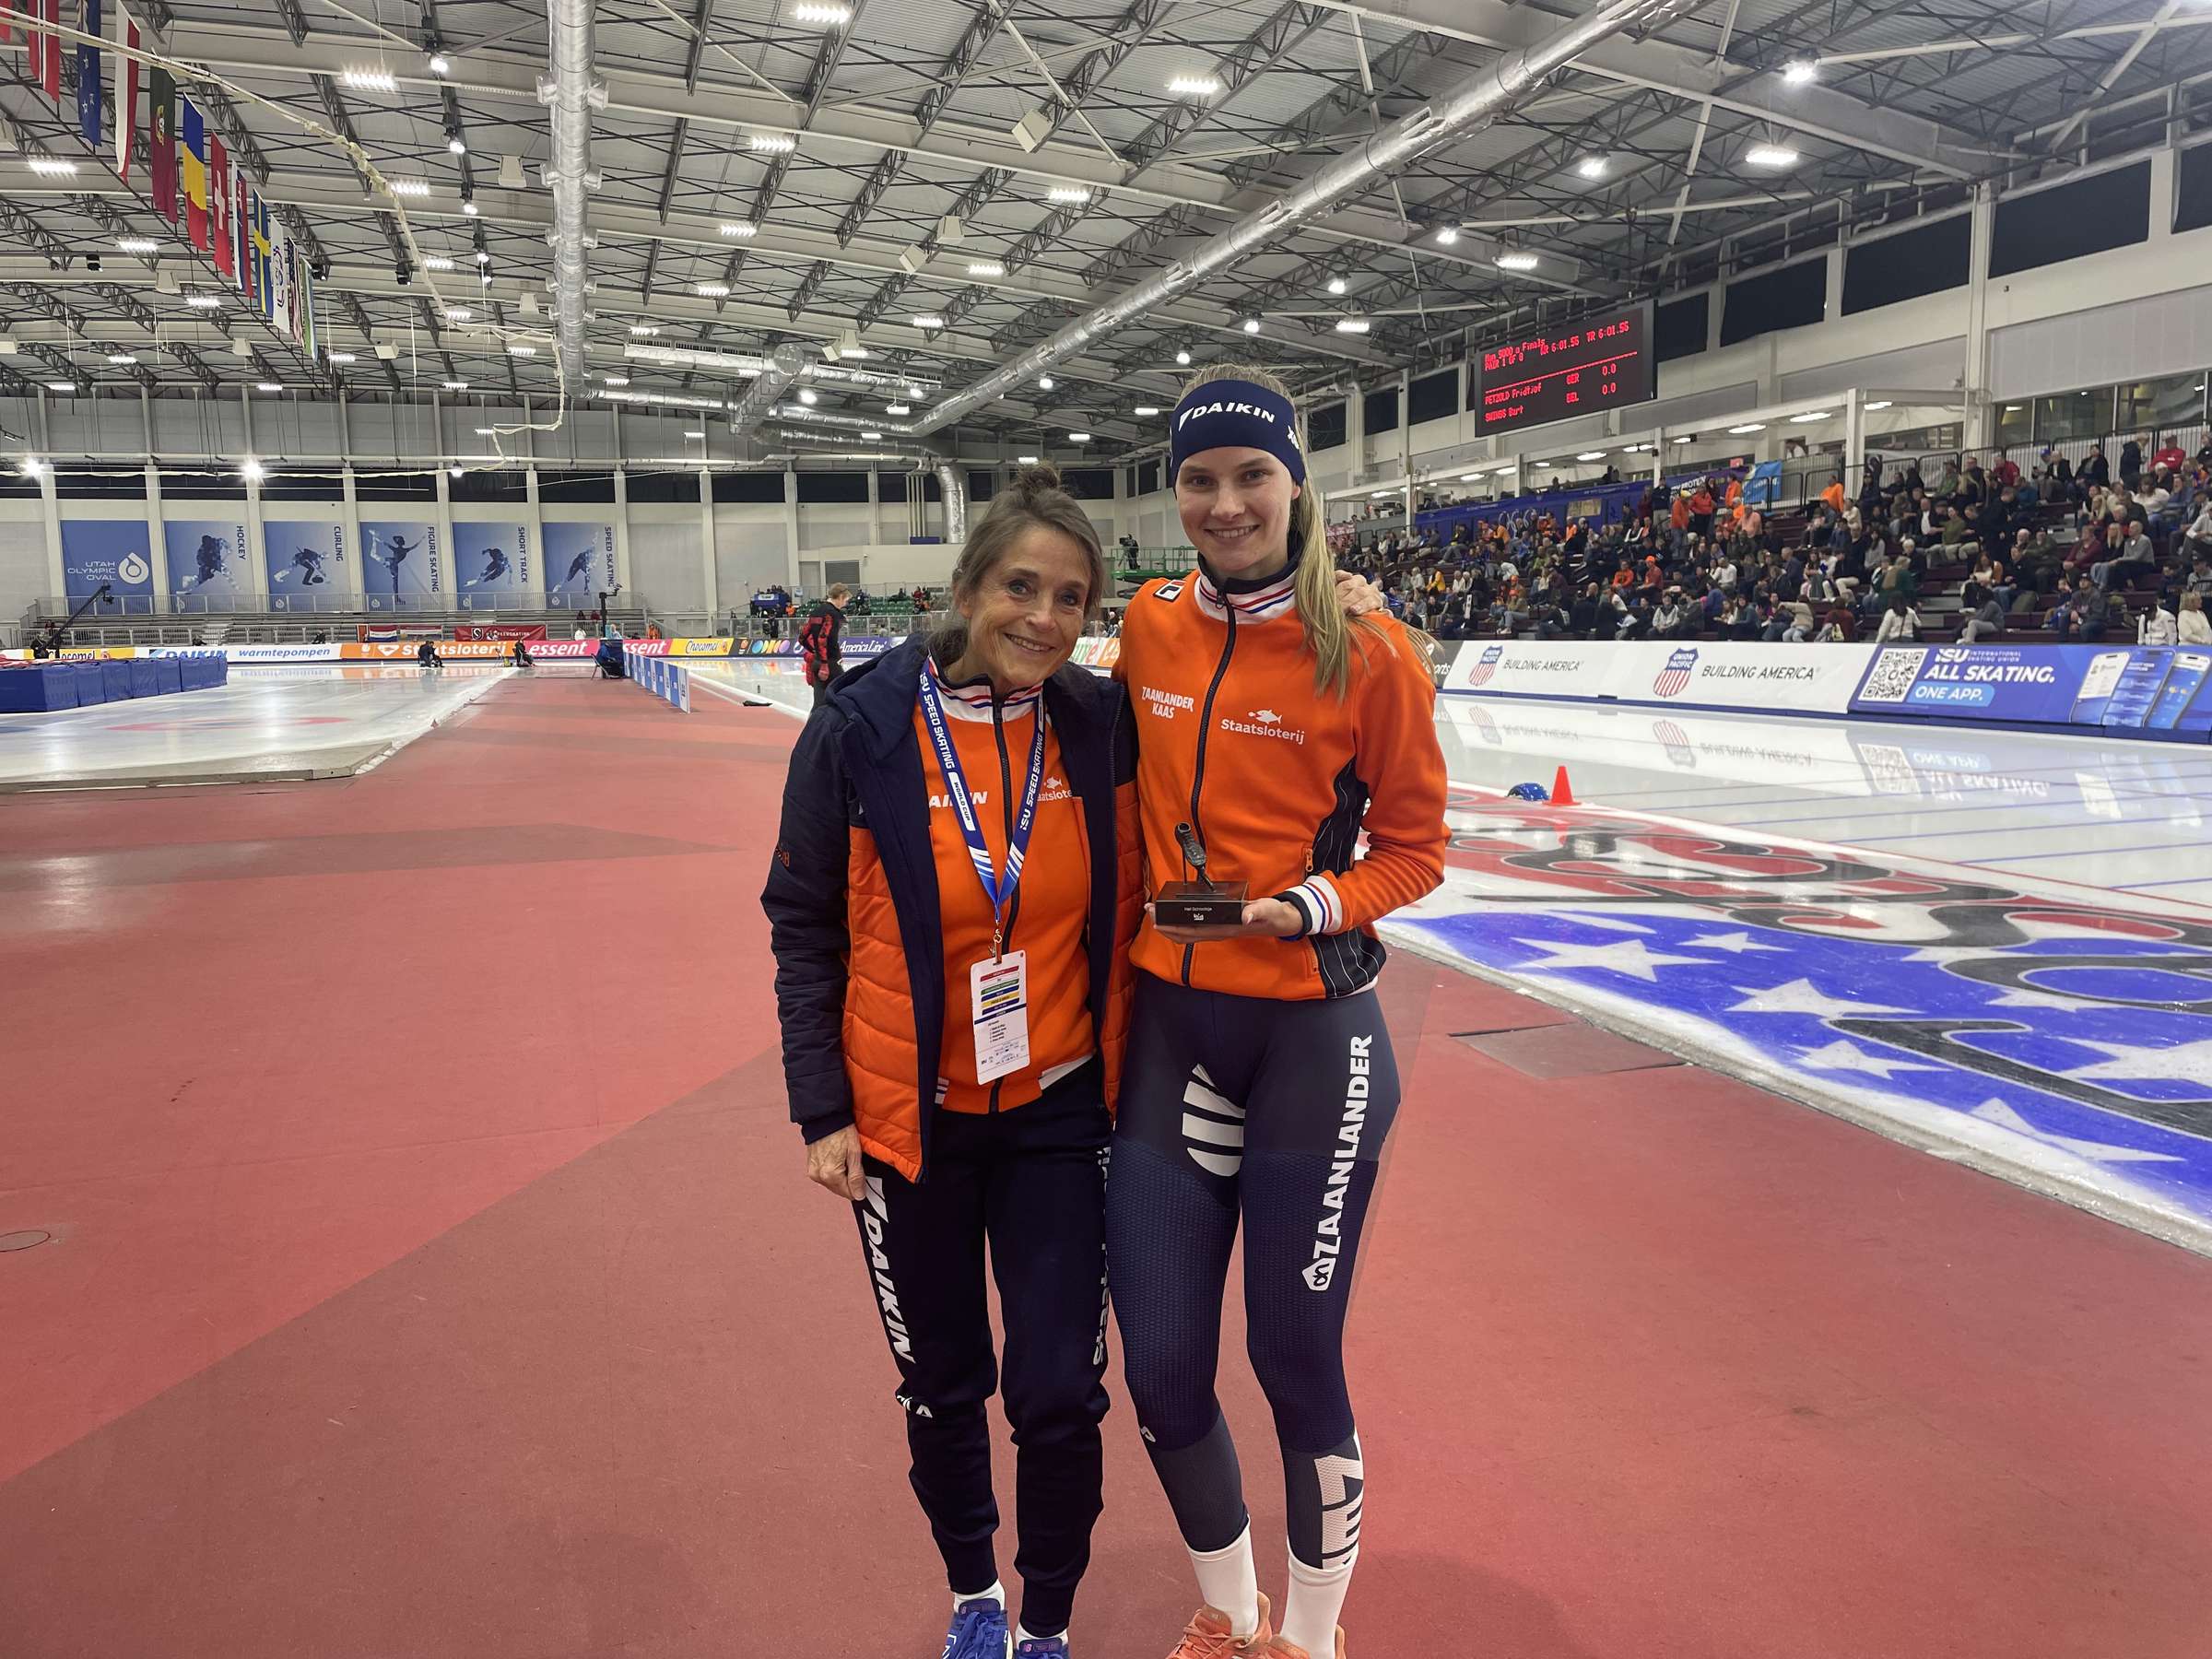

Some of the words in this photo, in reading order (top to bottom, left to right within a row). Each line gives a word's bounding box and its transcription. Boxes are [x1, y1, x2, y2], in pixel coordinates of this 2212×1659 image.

[1602, 363, 1617, 376] 0.0
[1191, 402, 1276, 423] DAIKIN
[236, 525, 247, 560] HOCKEY
[334, 525, 344, 561] CURLING
[427, 526, 437, 556] FIGURE
[517, 526, 526, 556] SHORT
[604, 526, 613, 552] SPEED
[429, 557, 440, 593] SKATING
[519, 556, 528, 583] TRACK
[49, 650, 96, 660] Cocomel
[239, 648, 331, 658] warmtepompen
[401, 641, 506, 656] Sttsloterij
[529, 641, 588, 655] essent
[623, 641, 667, 654] ssent
[1673, 653, 1695, 661] UNION
[1935, 649, 1970, 663] ISU
[1503, 659, 1541, 670] BUILDING
[1669, 660, 1693, 668] PACIFIC
[1701, 665, 1756, 679] BUILDING
[1924, 665, 1959, 679] ALL
[1963, 665, 2055, 683] SKATING.
[1142, 686, 1194, 712] ZAANLANDER
[1914, 686, 1948, 700] ONE
[1948, 688, 1983, 701] APP.
[1151, 703, 1175, 719] KAAS
[924, 694, 941, 725] SPEED
[934, 726, 955, 770] SKATING
[1220, 718, 1305, 745] Staatsloterij
[1032, 735, 1043, 773] SKATING
[929, 791, 988, 808] AIN
[1026, 774, 1039, 807] SPEED
[1020, 809, 1030, 830] ISU
[1312, 1034, 1372, 1259] ZAANLANDER
[863, 1209, 916, 1364] DAIKIN
